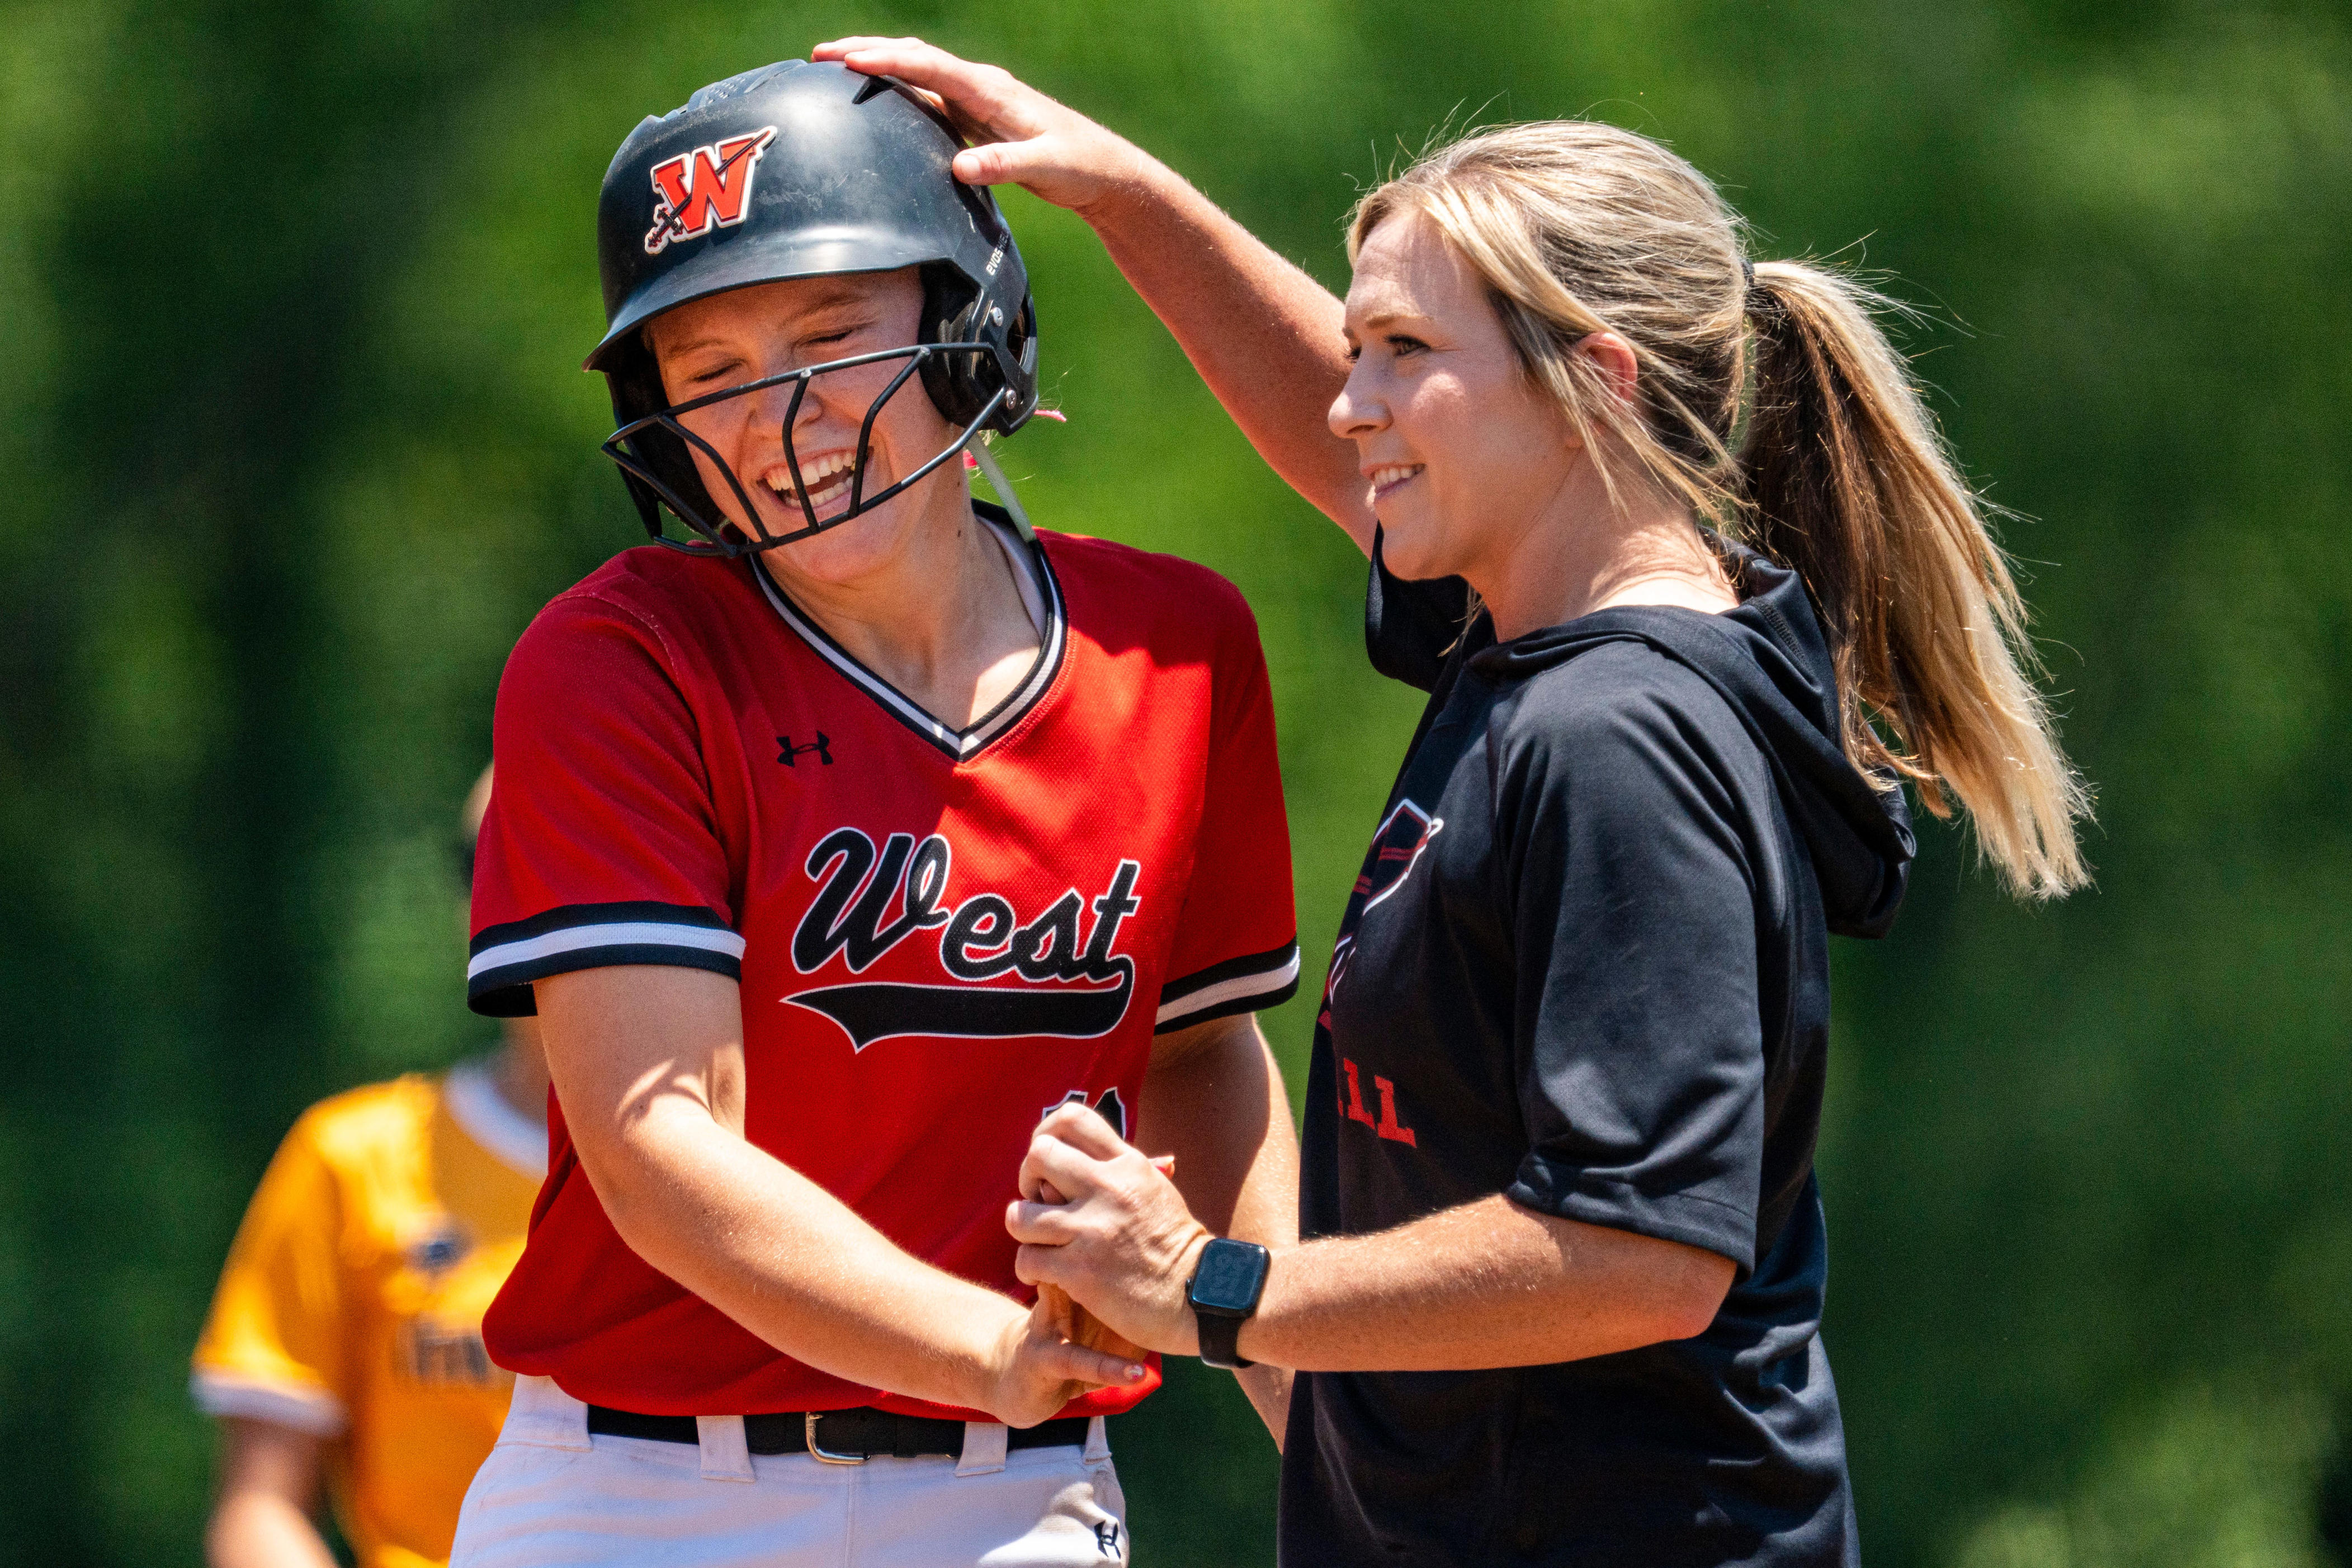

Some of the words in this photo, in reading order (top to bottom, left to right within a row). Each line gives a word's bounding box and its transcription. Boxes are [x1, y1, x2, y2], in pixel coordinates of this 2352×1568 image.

[650, 132, 763, 235] W
[790, 826, 1142, 983] West
[1338, 1057, 1417, 1149] LL
